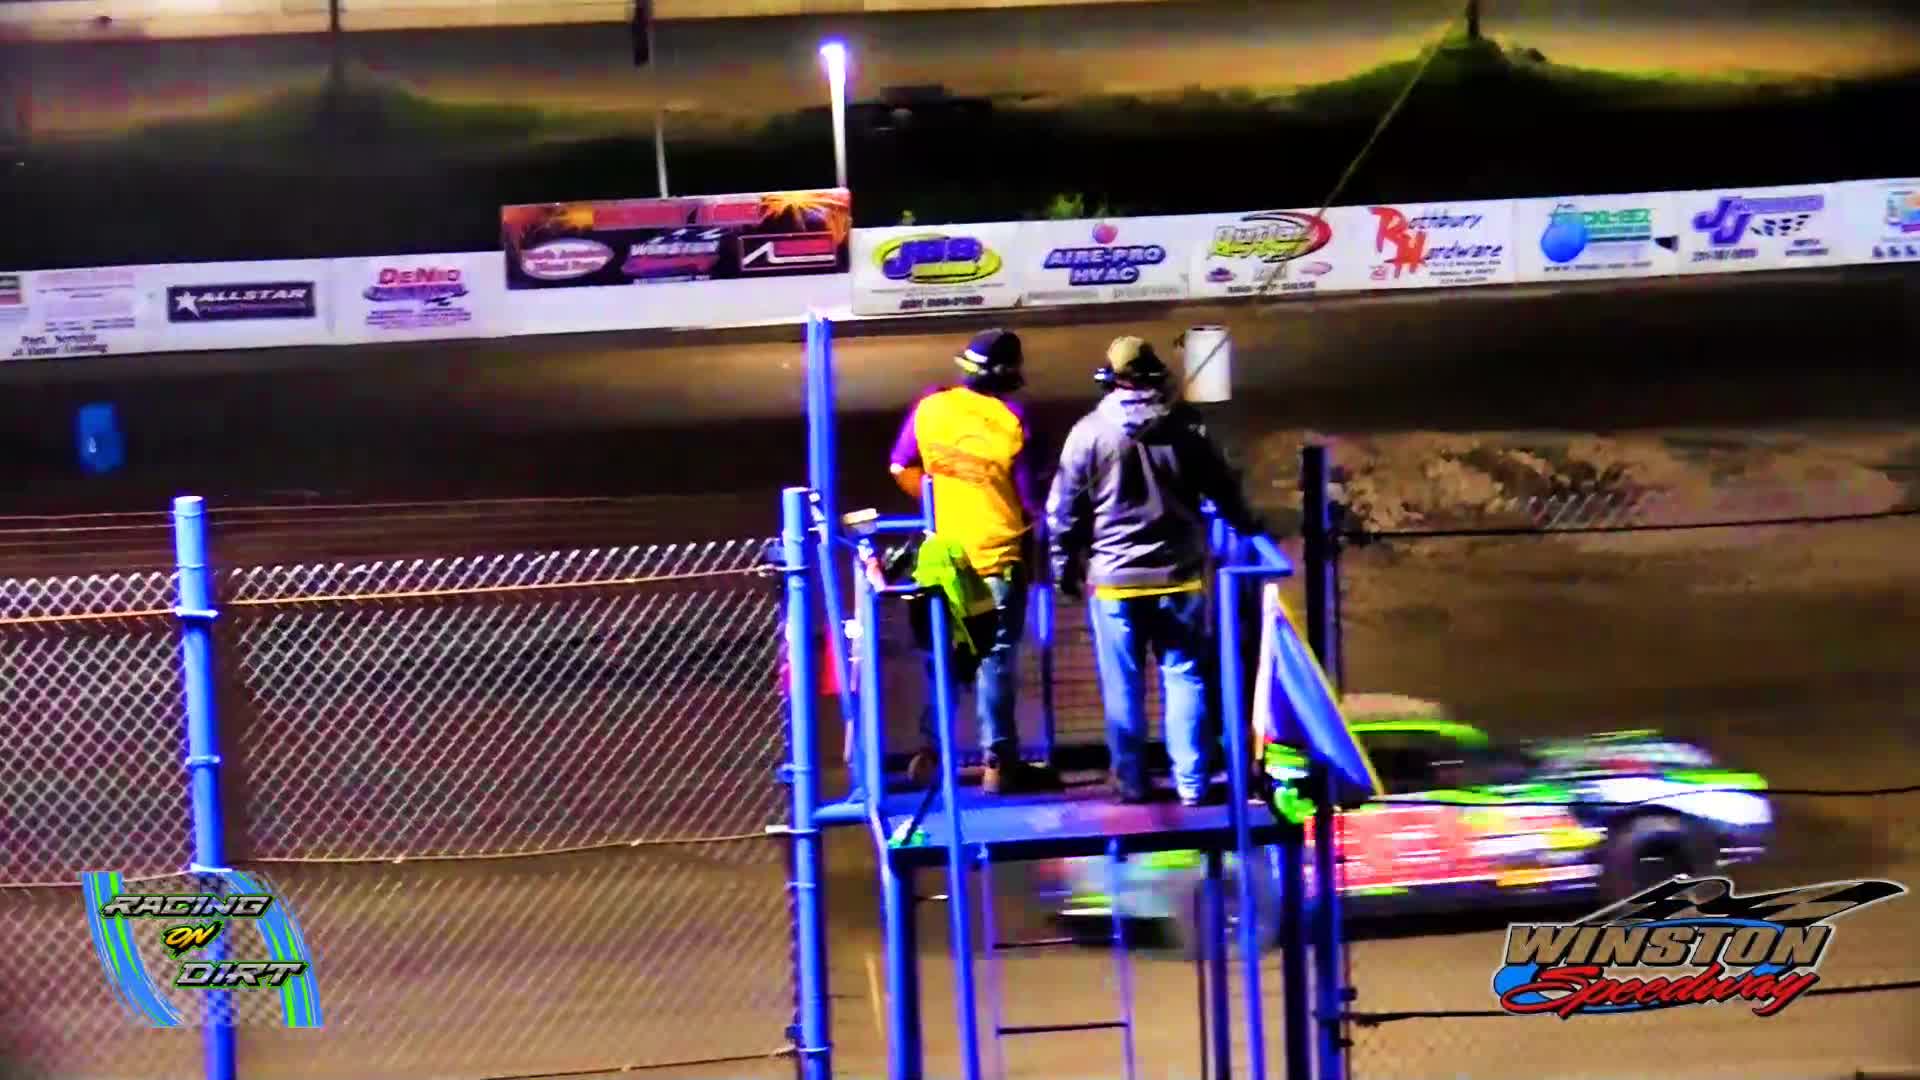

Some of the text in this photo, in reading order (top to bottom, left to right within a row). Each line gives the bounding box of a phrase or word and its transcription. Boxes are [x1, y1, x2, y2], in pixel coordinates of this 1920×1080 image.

[1045, 246, 1165, 268] AIRE-PRO
[1070, 265, 1139, 285] HVAC
[197, 289, 307, 302] ALLSTAR
